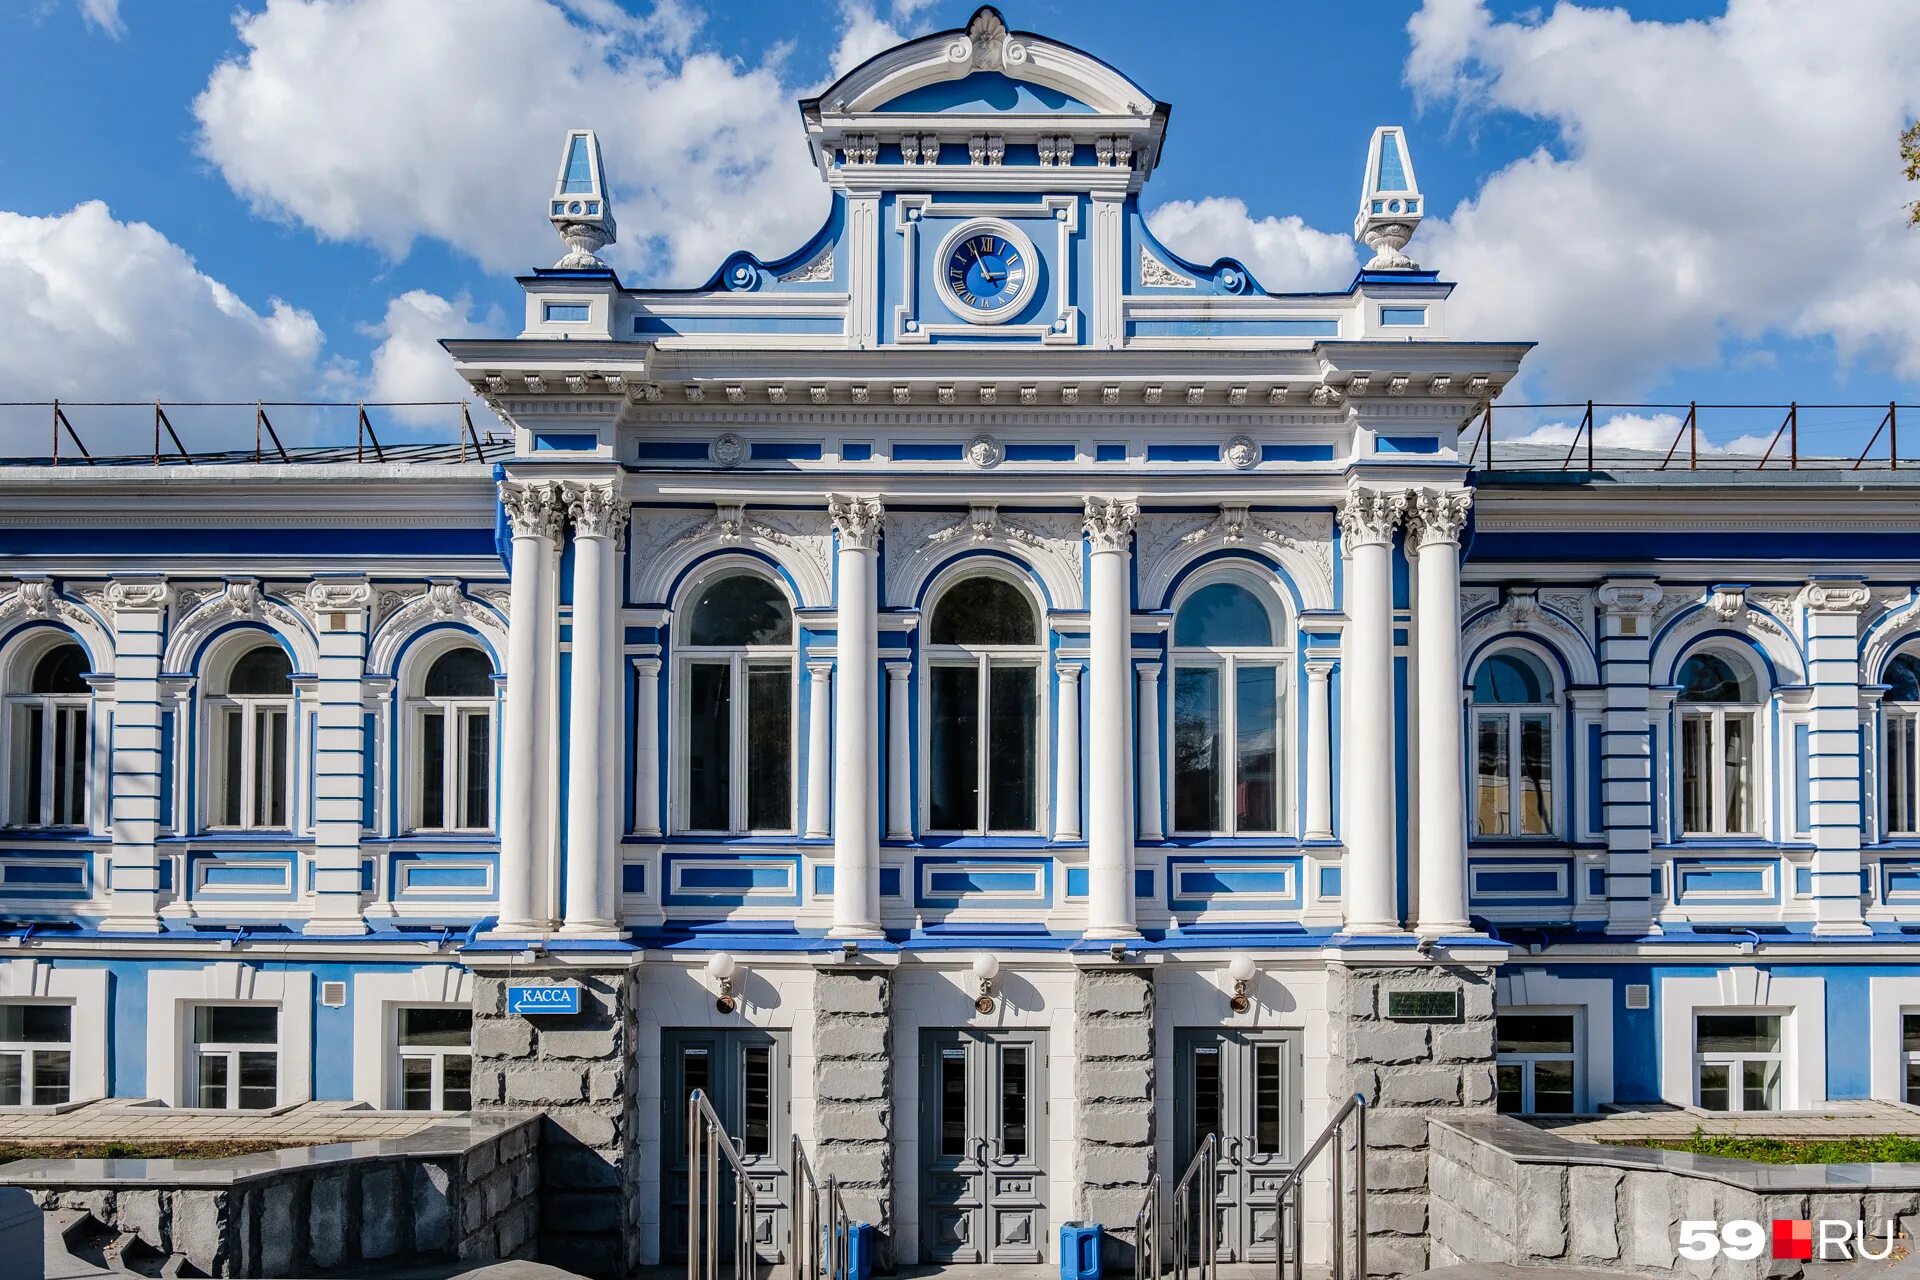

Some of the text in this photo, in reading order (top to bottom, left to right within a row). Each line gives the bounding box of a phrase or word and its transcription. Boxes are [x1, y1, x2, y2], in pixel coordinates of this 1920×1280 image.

[981, 237, 993, 252] XII
[998, 242, 1006, 255] I
[1006, 253, 1018, 266] II
[522, 989, 571, 1002] КАССА
